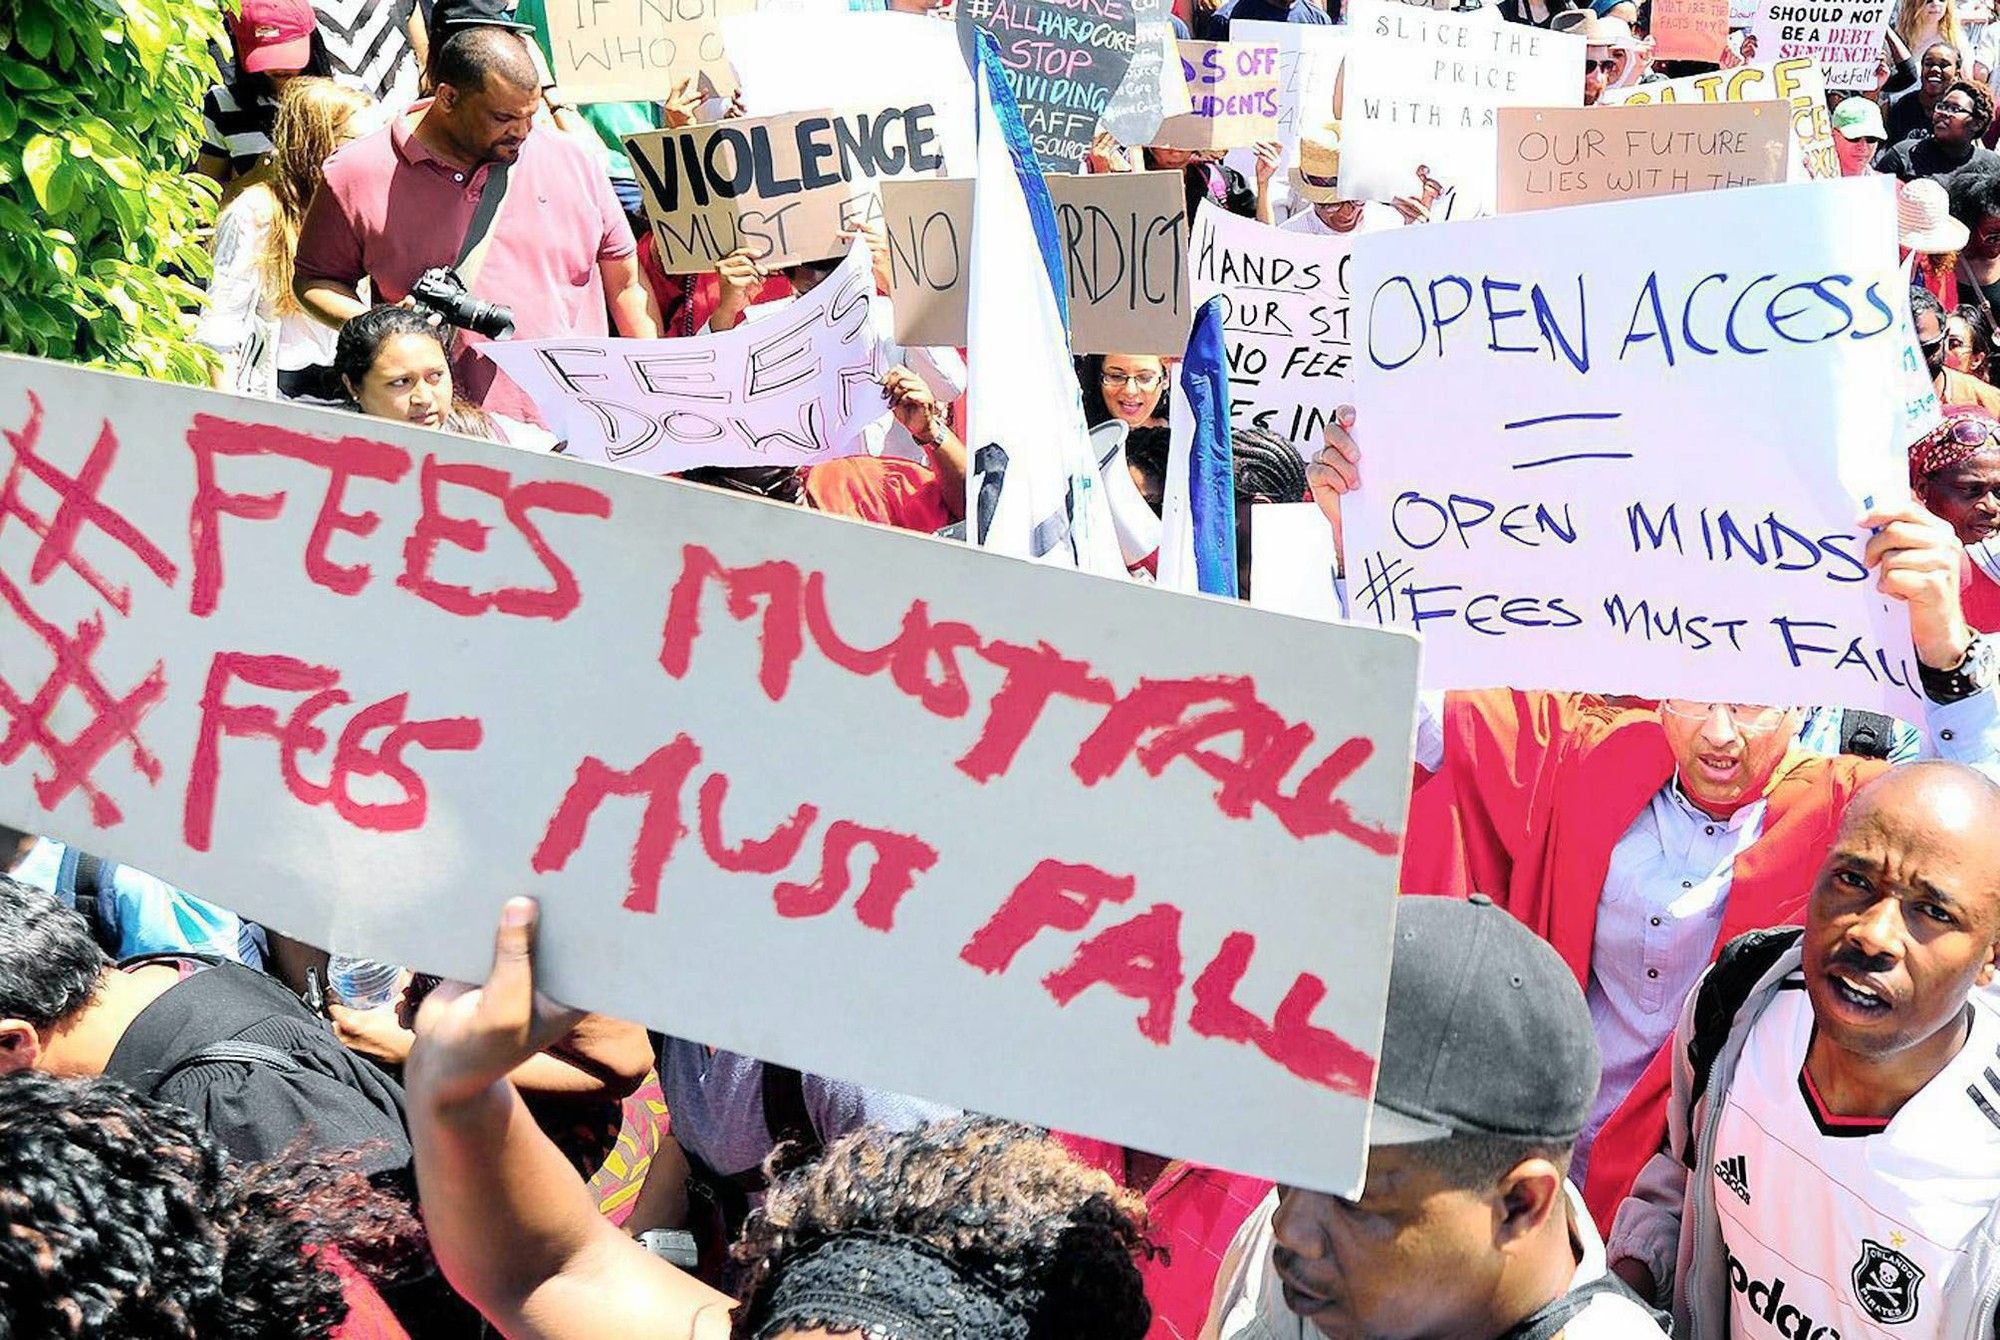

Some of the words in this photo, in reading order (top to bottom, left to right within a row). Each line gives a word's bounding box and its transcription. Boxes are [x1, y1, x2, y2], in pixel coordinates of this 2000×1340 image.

[1769, 6, 1843, 23] SHOULD
[1850, 9, 1882, 24] NOT
[568, 36, 676, 71] WHO
[1493, 32, 1540, 56] THE
[1782, 26, 1805, 41] BE
[1808, 28, 1820, 42] A
[1827, 29, 1875, 45] DEBT
[1001, 39, 1093, 79] STOP
[1236, 48, 1278, 76] OFF
[1018, 104, 1094, 138] TAFF
[1190, 88, 1278, 118] UDENTS
[625, 104, 943, 212] VIOLENCE
[1030, 133, 1092, 162] SOURCE
[1518, 129, 1605, 165] OUR
[1626, 130, 1748, 157] FUTURE
[1526, 171, 1588, 194] LIES
[1606, 168, 1689, 192] WITH
[657, 202, 800, 264] MUST
[839, 191, 885, 233] FA
[886, 211, 960, 292] NO
[1055, 203, 1184, 315] RDICT
[1198, 217, 1321, 290] HANDS
[535, 270, 871, 403] FEES
[1368, 272, 1590, 374] OPEN
[1620, 270, 1894, 366] ACCESS
[1225, 343, 1267, 374] NO
[1281, 347, 1351, 379] FEE
[1392, 491, 1576, 551] OPEN
[1627, 503, 1870, 582] MINDS
[1355, 552, 1583, 636] #FEES
[1604, 595, 1748, 651] MUST
[531, 733, 939, 932] MUST
[959, 858, 1376, 1099] FALL
[1869, 1249, 1914, 1279] ORLANDO
[1860, 1287, 1902, 1317] PIRATES
